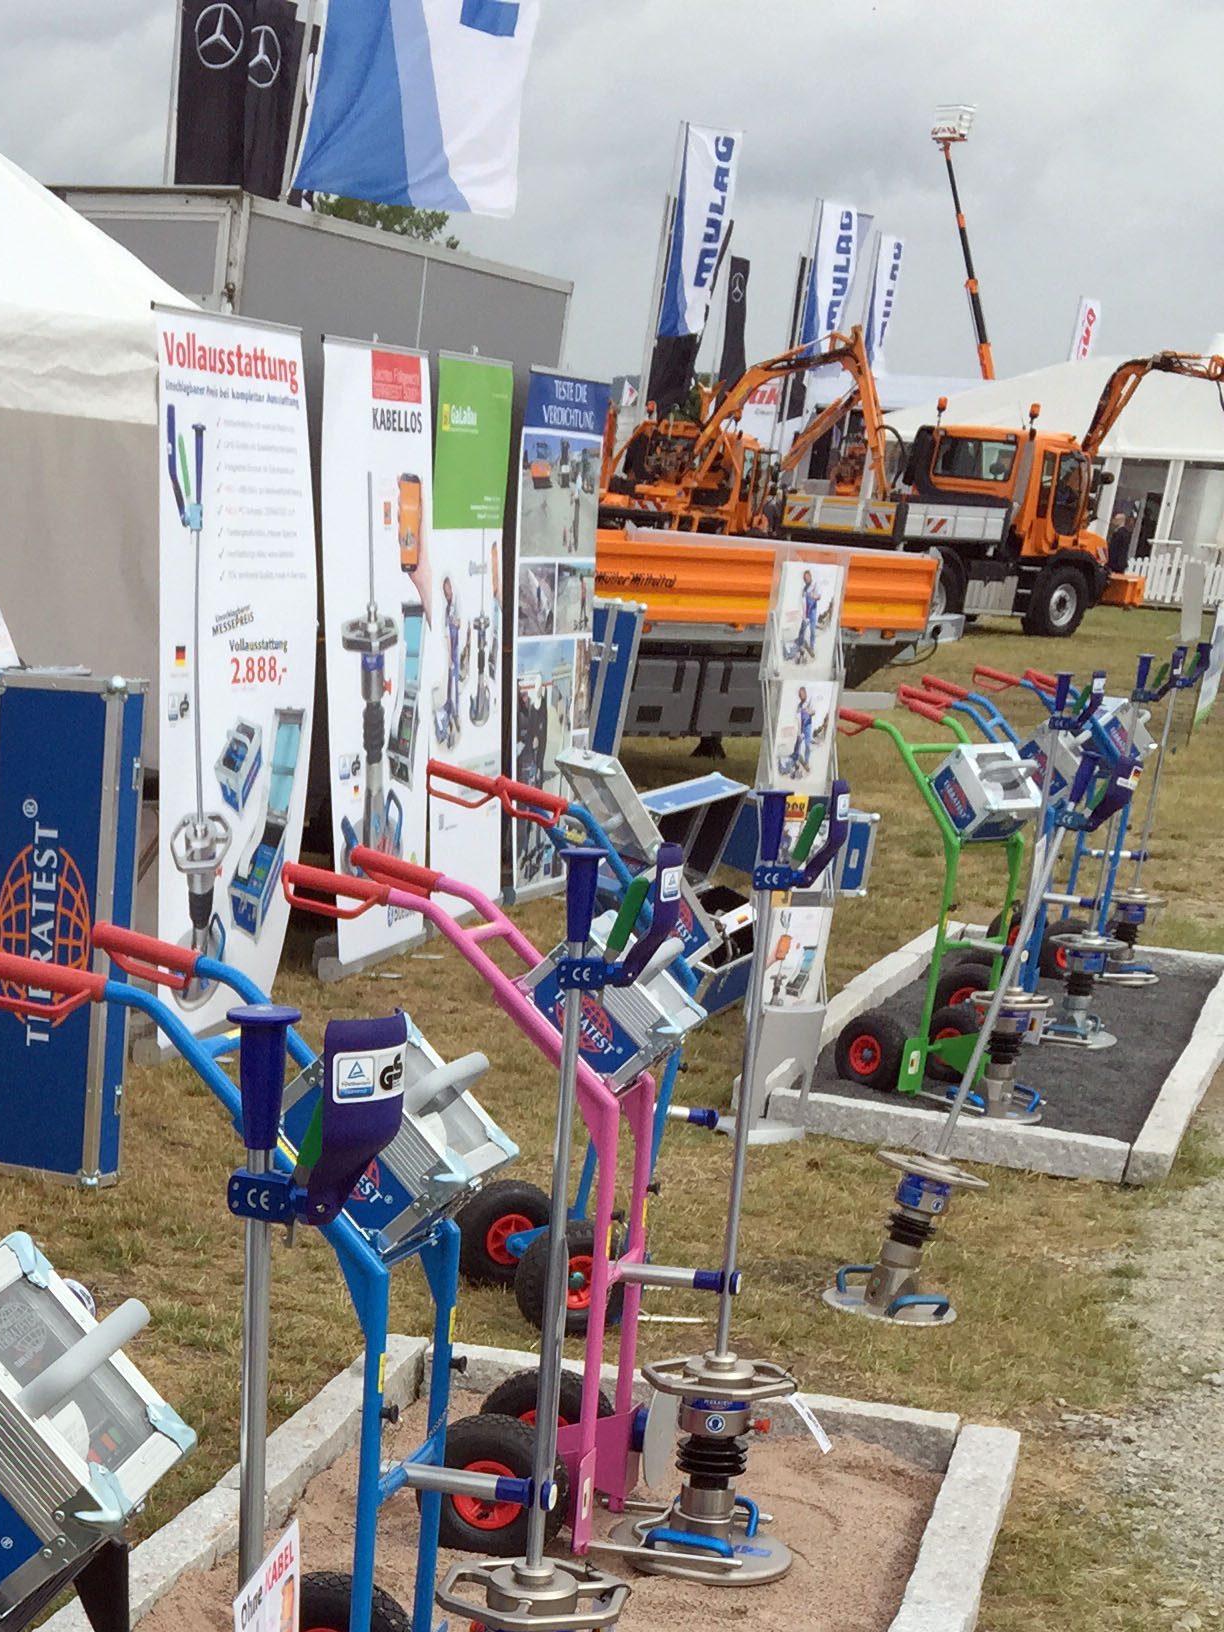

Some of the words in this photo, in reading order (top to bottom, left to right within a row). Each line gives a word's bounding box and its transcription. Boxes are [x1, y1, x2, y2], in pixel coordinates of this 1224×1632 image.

[694, 135, 736, 289] MULAG
[826, 210, 854, 331] MULAG
[163, 331, 299, 394] Vollausstattung
[165, 379, 205, 396] Unschlagbarer
[219, 386, 229, 399] bei
[554, 380, 574, 401] TESTE
[575, 383, 588, 403] DIE
[372, 407, 423, 434] KABELLOS
[542, 404, 595, 430] VERDICHTUNG
[211, 611, 255, 637] MESSEPREIS
[229, 639, 288, 653] Vollausstattung
[230, 655, 287, 686] 2.888,-
[26, 821, 60, 1046] TRATEST
[572, 966, 591, 983] CE
[247, 1187, 270, 1211] CE
[265, 1540, 294, 1594] KABEL
